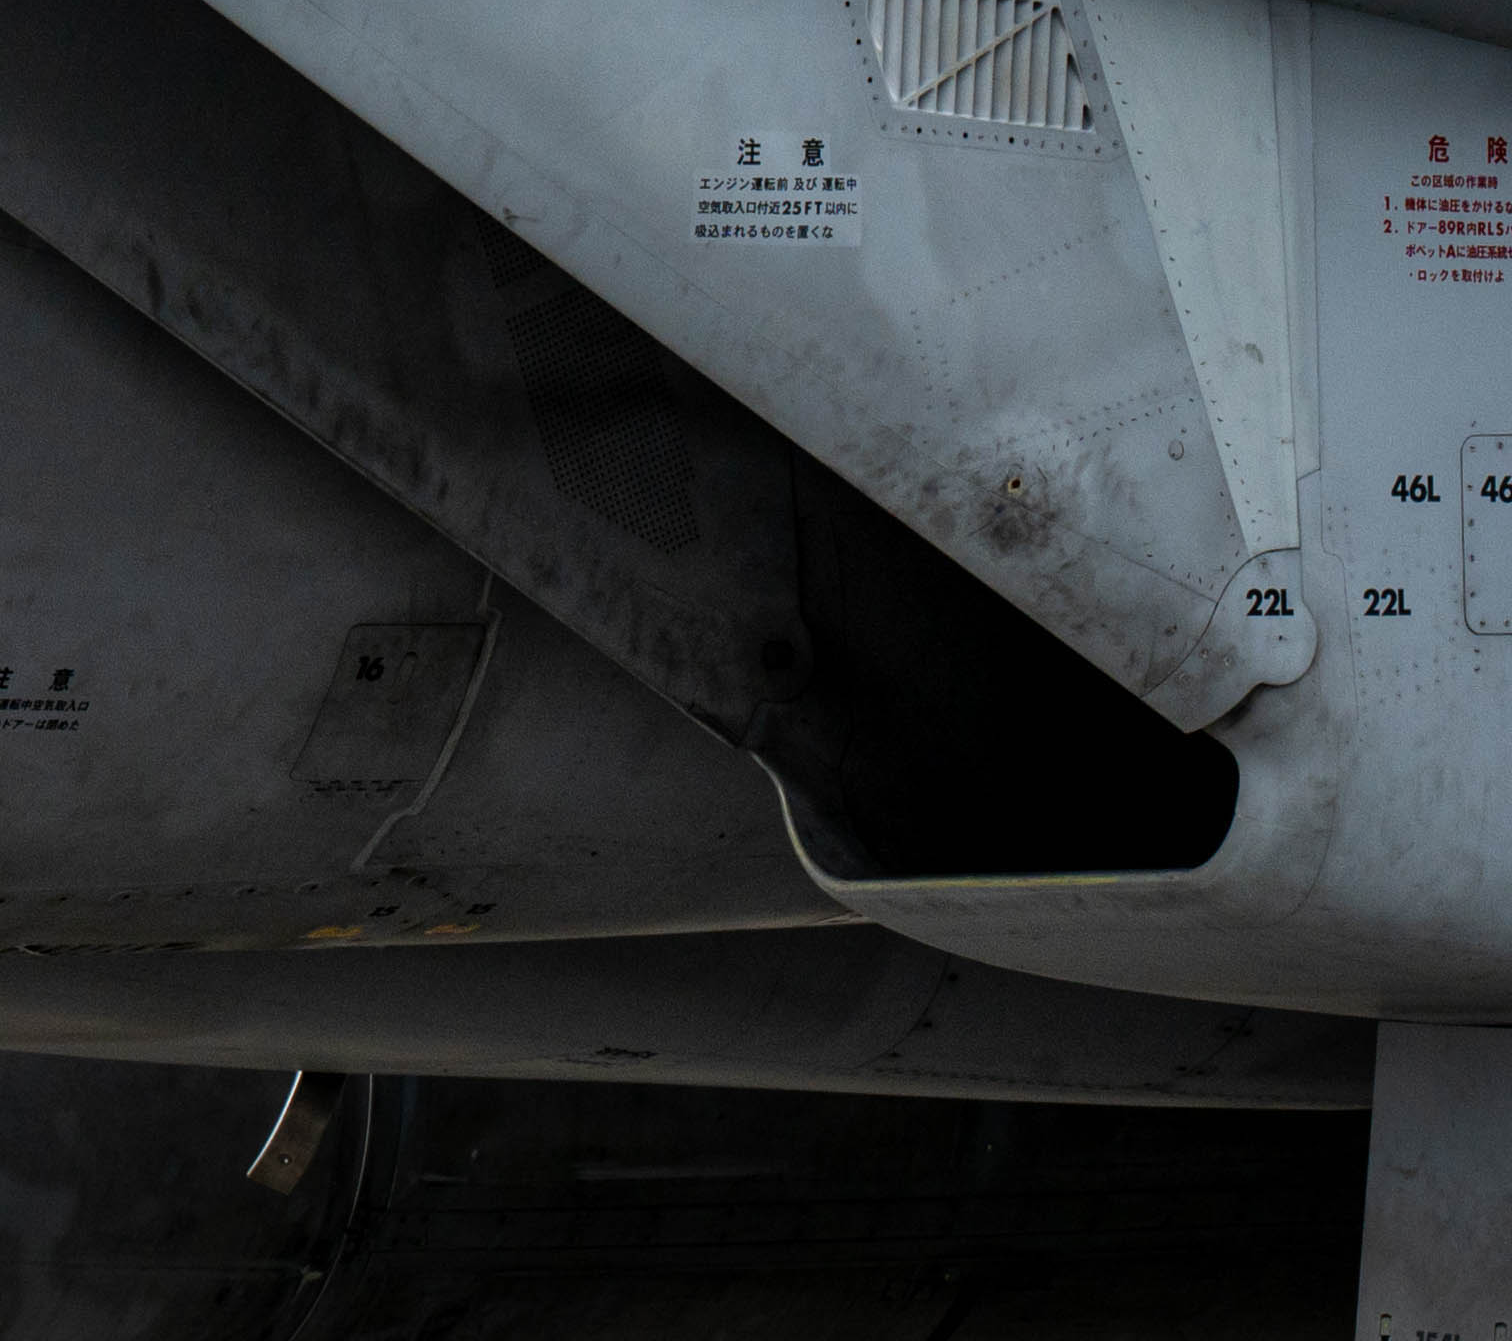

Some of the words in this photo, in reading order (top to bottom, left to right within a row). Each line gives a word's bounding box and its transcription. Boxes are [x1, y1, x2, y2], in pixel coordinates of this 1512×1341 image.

[737, 137, 825, 166] 注意
[1428, 134, 1508, 165] 危険
[1383, 196, 1398, 211] 1.
[1383, 219, 1399, 234] 2.
[1407, 220, 1512, 236] ドアー89R内RLS
[1391, 475, 1441, 503] 46L
[1246, 588, 1294, 616] 22L
[1364, 588, 1411, 616] 22L
[356, 655, 385, 681] 16
